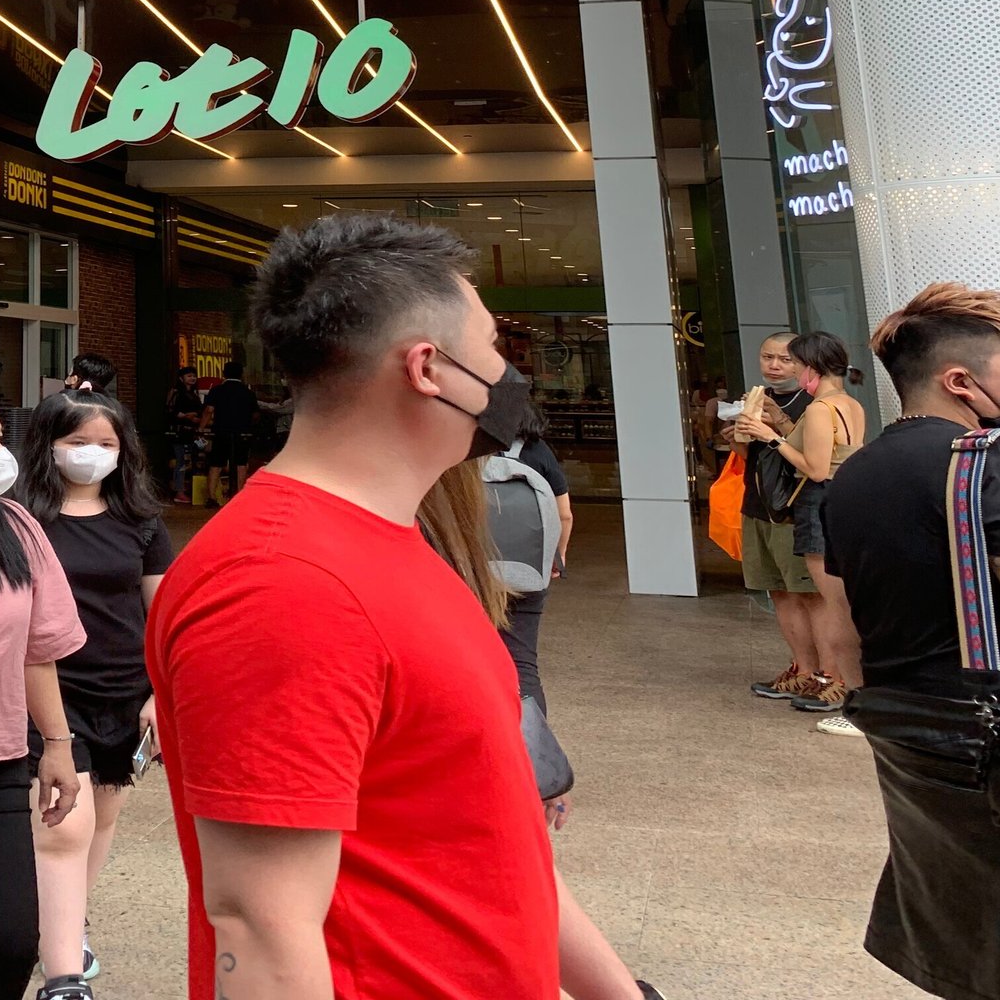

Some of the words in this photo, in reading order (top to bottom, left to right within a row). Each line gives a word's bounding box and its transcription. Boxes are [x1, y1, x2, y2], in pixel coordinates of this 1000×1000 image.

[266, 17, 418, 130] 10
[784, 140, 849, 176] mach
[788, 181, 854, 217] mach
